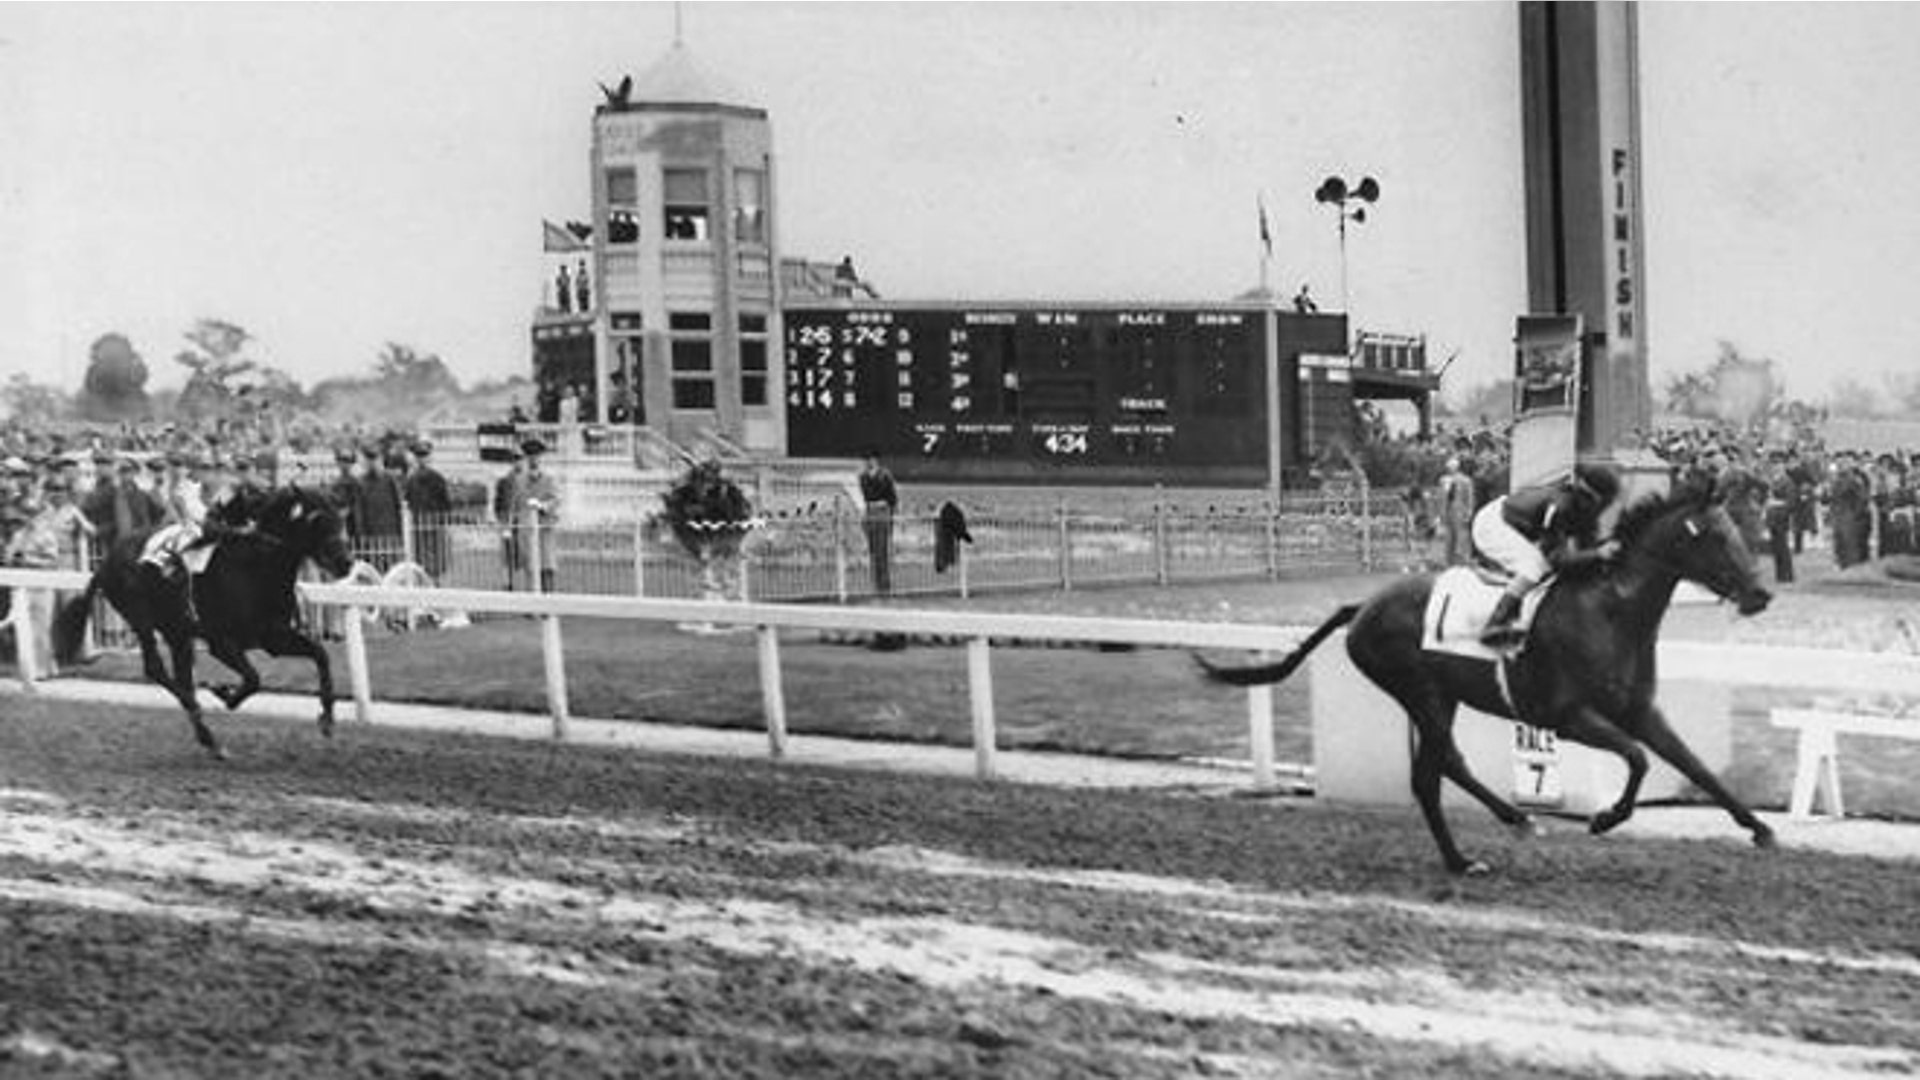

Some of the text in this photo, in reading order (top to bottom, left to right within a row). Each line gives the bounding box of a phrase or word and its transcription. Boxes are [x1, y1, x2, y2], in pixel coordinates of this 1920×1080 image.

[1612, 148, 1633, 338] FINISH
[817, 347, 832, 366] 7
[805, 368, 833, 387] 17
[806, 389, 832, 408] 14
[923, 433, 938, 453] 7
[1515, 724, 1556, 752] RACE
[1528, 763, 1547, 796] 7
